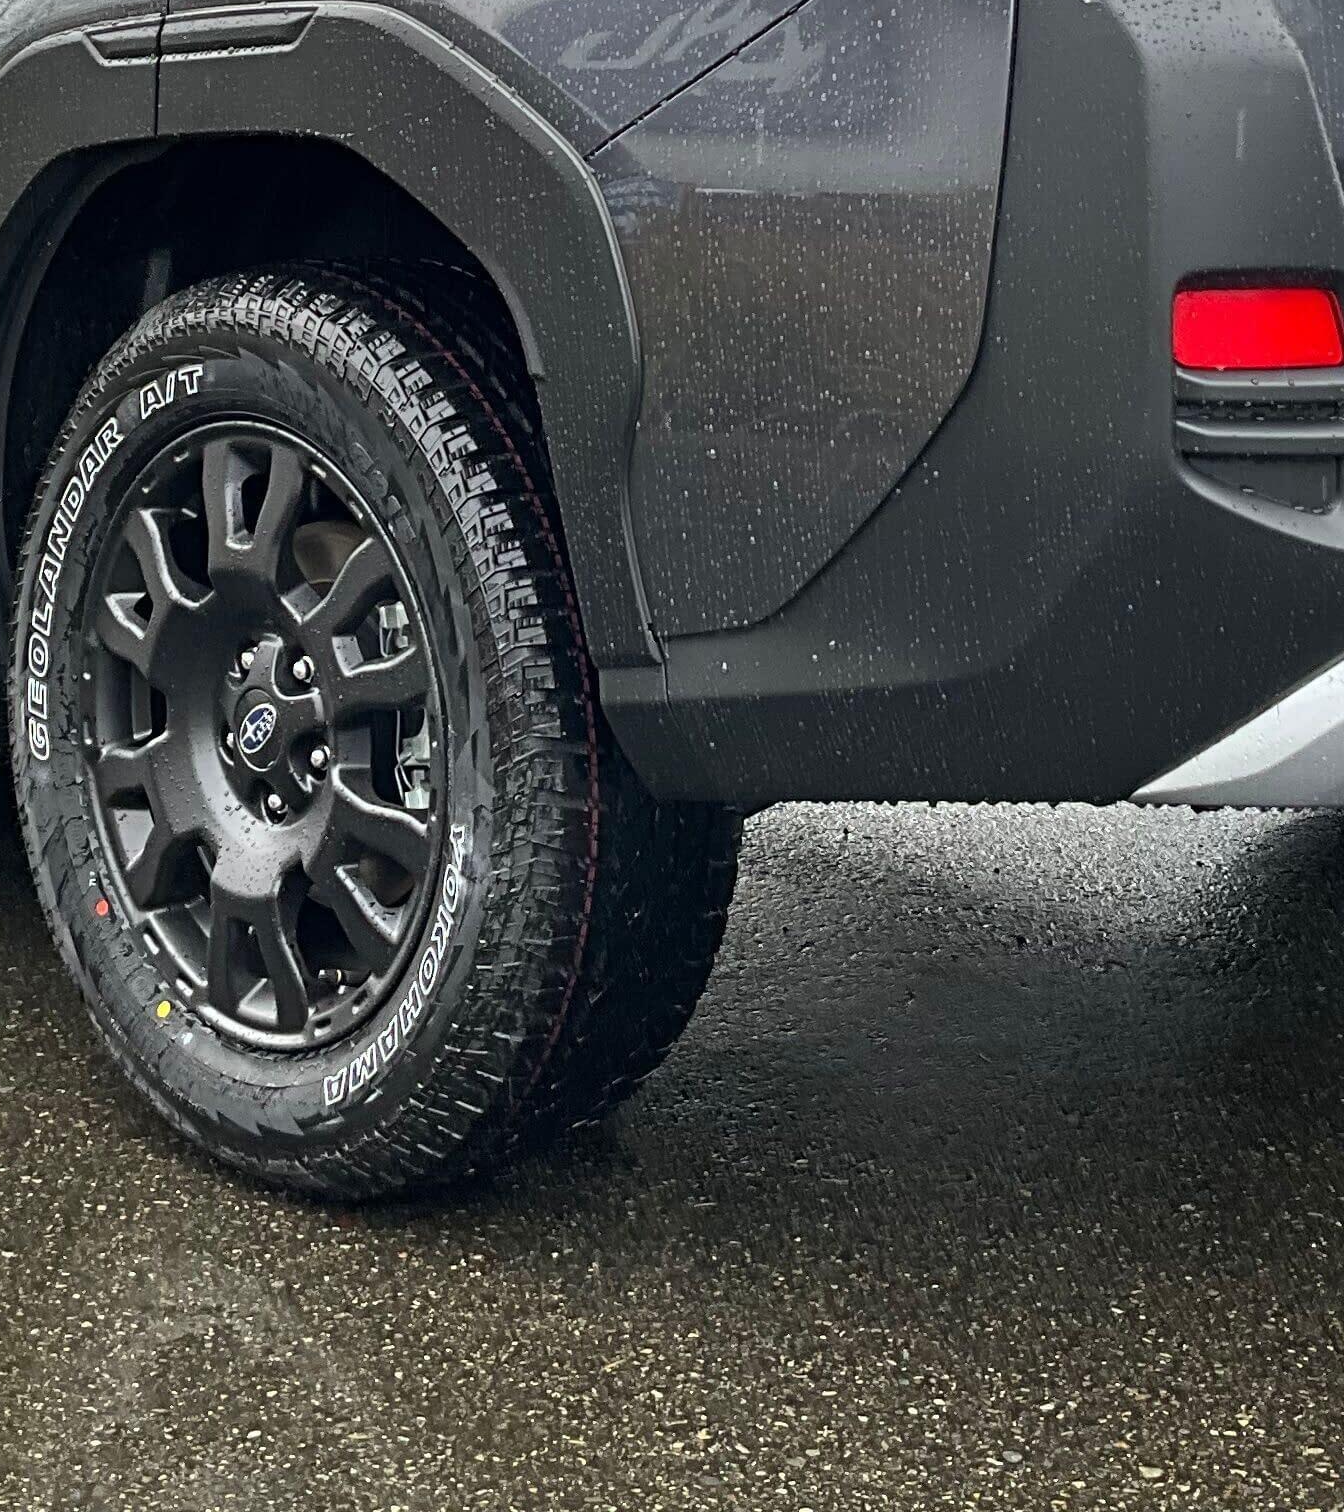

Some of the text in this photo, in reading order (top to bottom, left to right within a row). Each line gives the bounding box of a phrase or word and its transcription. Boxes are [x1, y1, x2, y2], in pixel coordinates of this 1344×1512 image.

[28, 364, 203, 761] GEOLANDAR A/T
[323, 824, 468, 1106] YOKOHAMA
